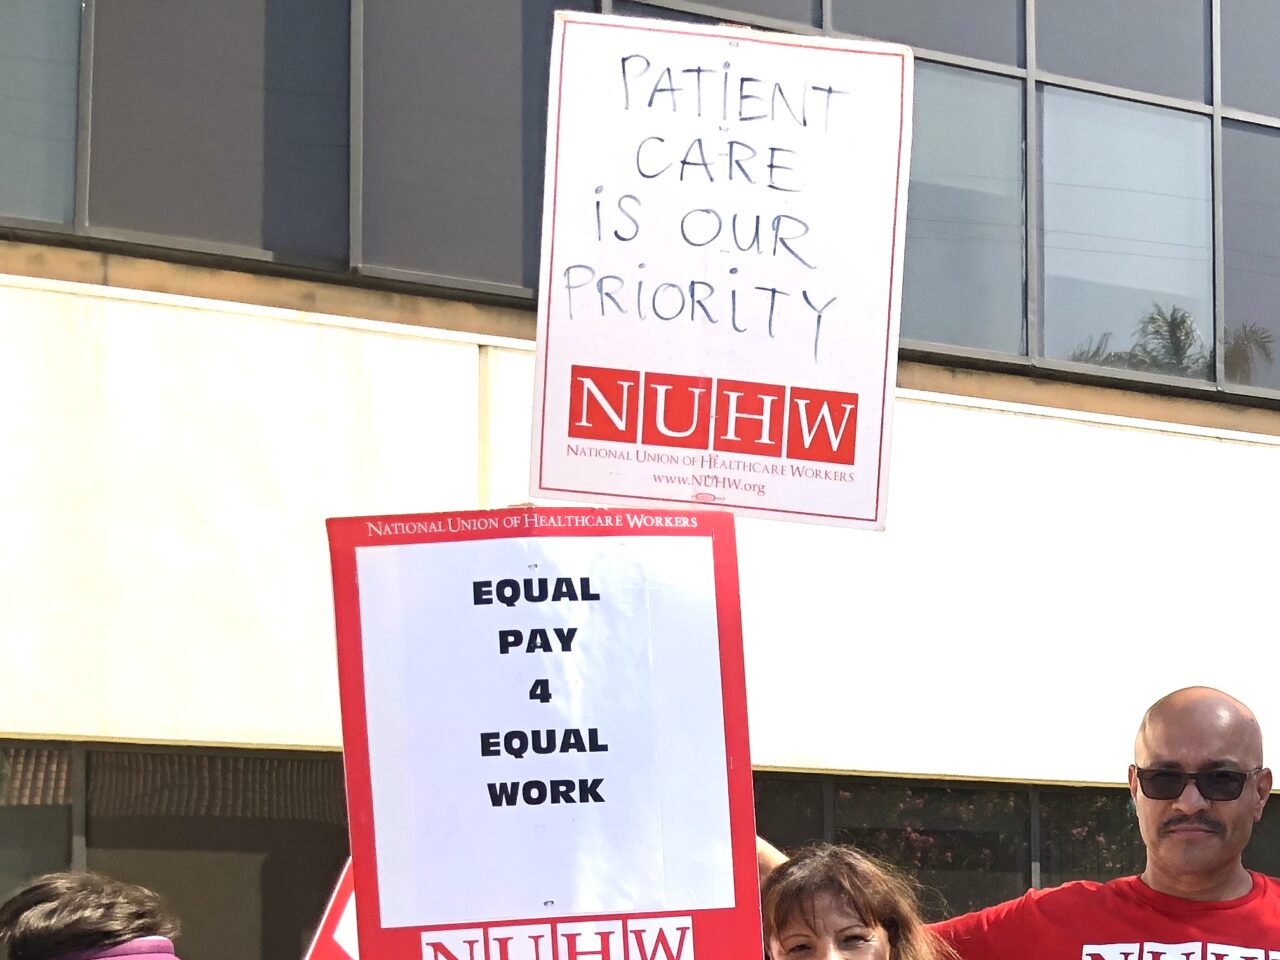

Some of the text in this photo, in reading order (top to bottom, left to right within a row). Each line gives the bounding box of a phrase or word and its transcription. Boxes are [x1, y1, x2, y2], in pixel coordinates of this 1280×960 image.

[636, 136, 803, 193] CARE
[681, 208, 817, 269] OUR
[575, 376, 857, 453] NUHW
[566, 444, 854, 482] NATIONAL UNION OF HEALTHCARE WORKERS
[653, 473, 766, 496] www.NUHW.org
[366, 513, 698, 537] NATIONAL UNION OF HEALTHCARE WORKERS
[472, 576, 601, 607] EQUAL
[498, 626, 579, 655] PAY
[527, 678, 552, 704] 4
[479, 727, 609, 758] EQUAL
[486, 777, 606, 807] WORK
